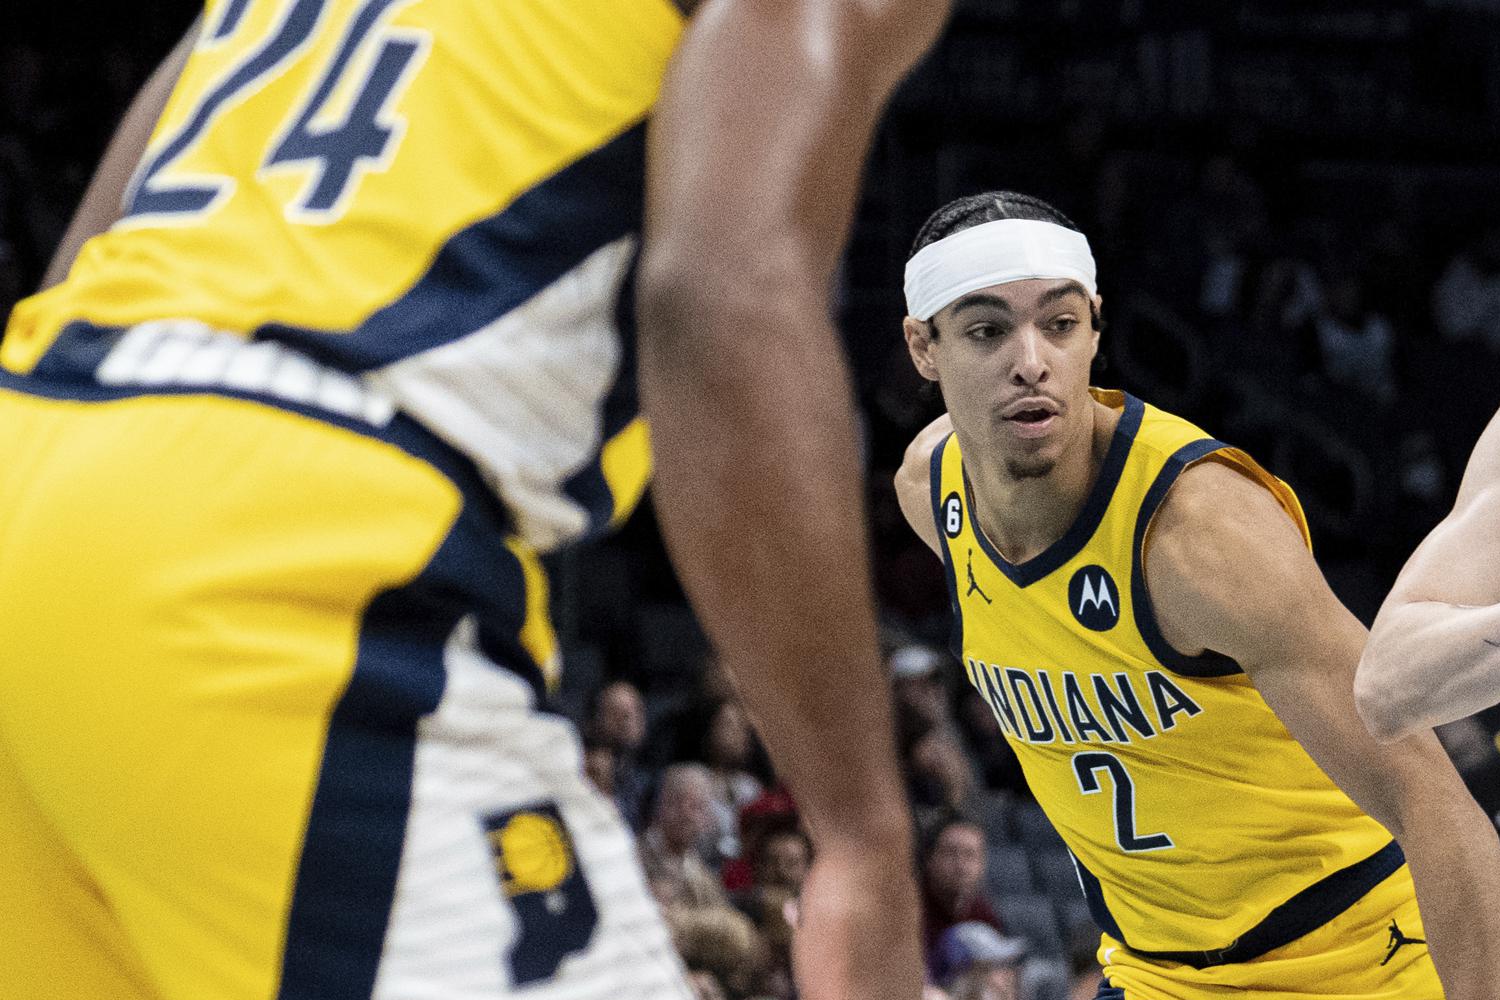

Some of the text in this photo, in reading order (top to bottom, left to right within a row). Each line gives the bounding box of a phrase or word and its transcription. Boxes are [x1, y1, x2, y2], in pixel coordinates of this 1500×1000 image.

[118, 0, 432, 227] 24
[946, 498, 960, 533] 6
[969, 657, 1204, 745] INDIANA
[1071, 751, 1175, 853] 2
